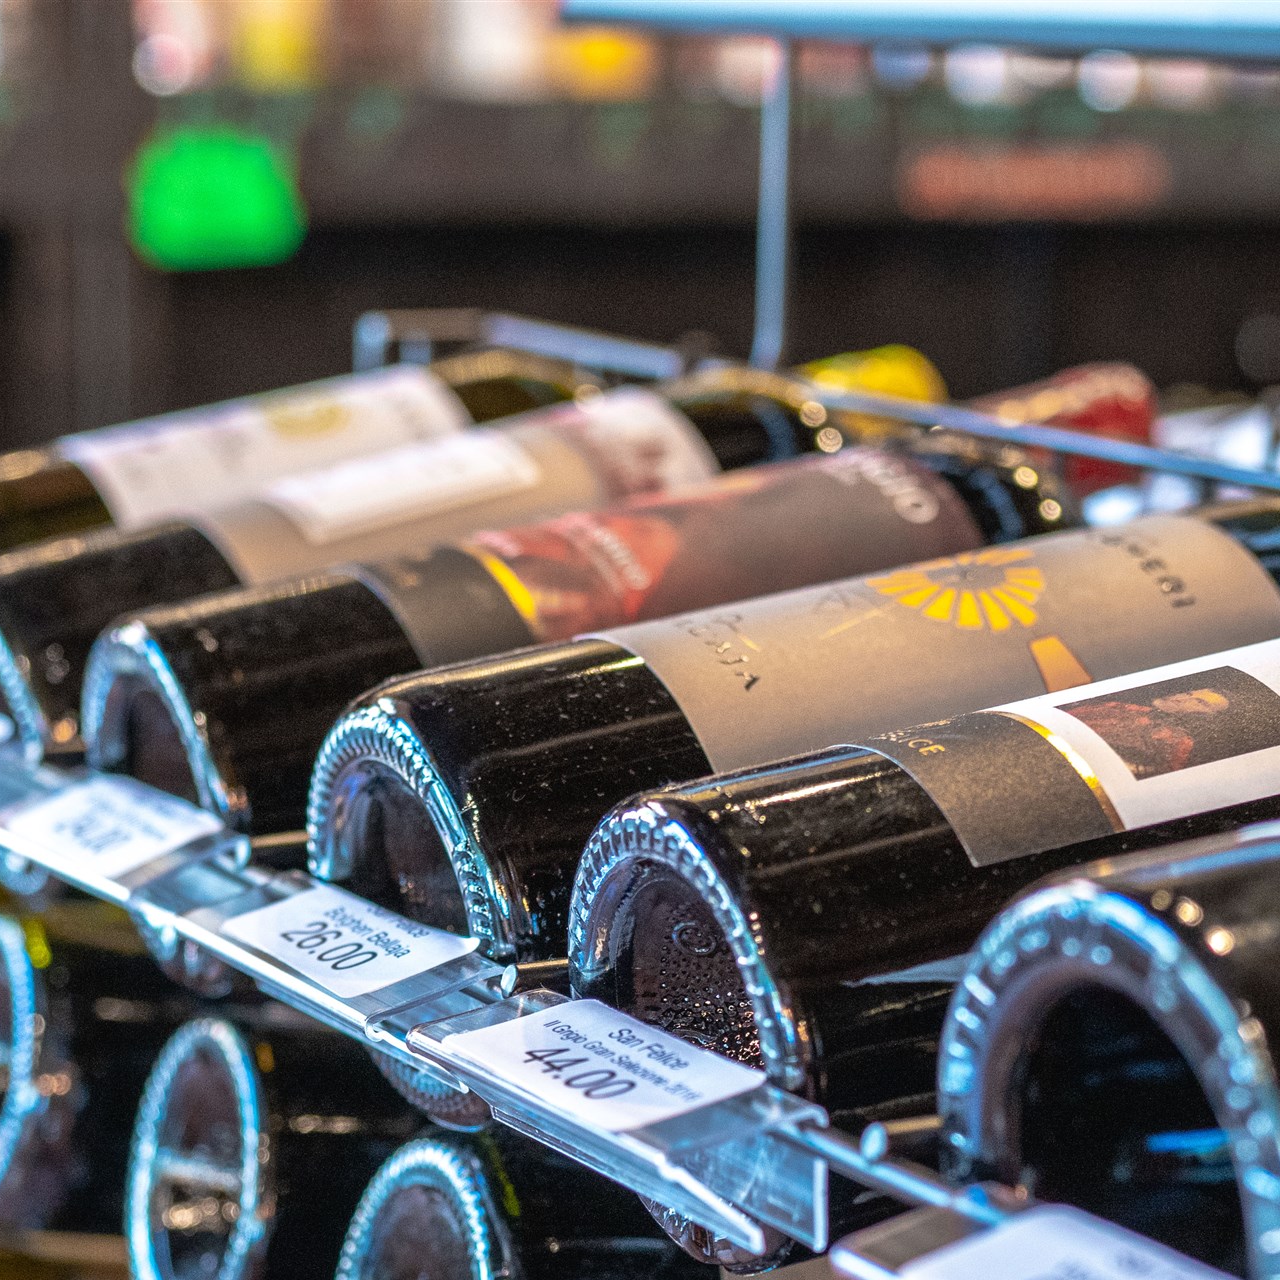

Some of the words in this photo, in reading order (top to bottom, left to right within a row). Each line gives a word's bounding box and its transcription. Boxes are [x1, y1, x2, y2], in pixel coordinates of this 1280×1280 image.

[280, 921, 378, 971] 26.00
[553, 1023, 585, 1044] Grigio
[583, 1039, 615, 1059] Gran
[607, 1027, 646, 1051] San
[645, 1040, 690, 1071] Felice
[523, 1047, 637, 1100] 44.00
